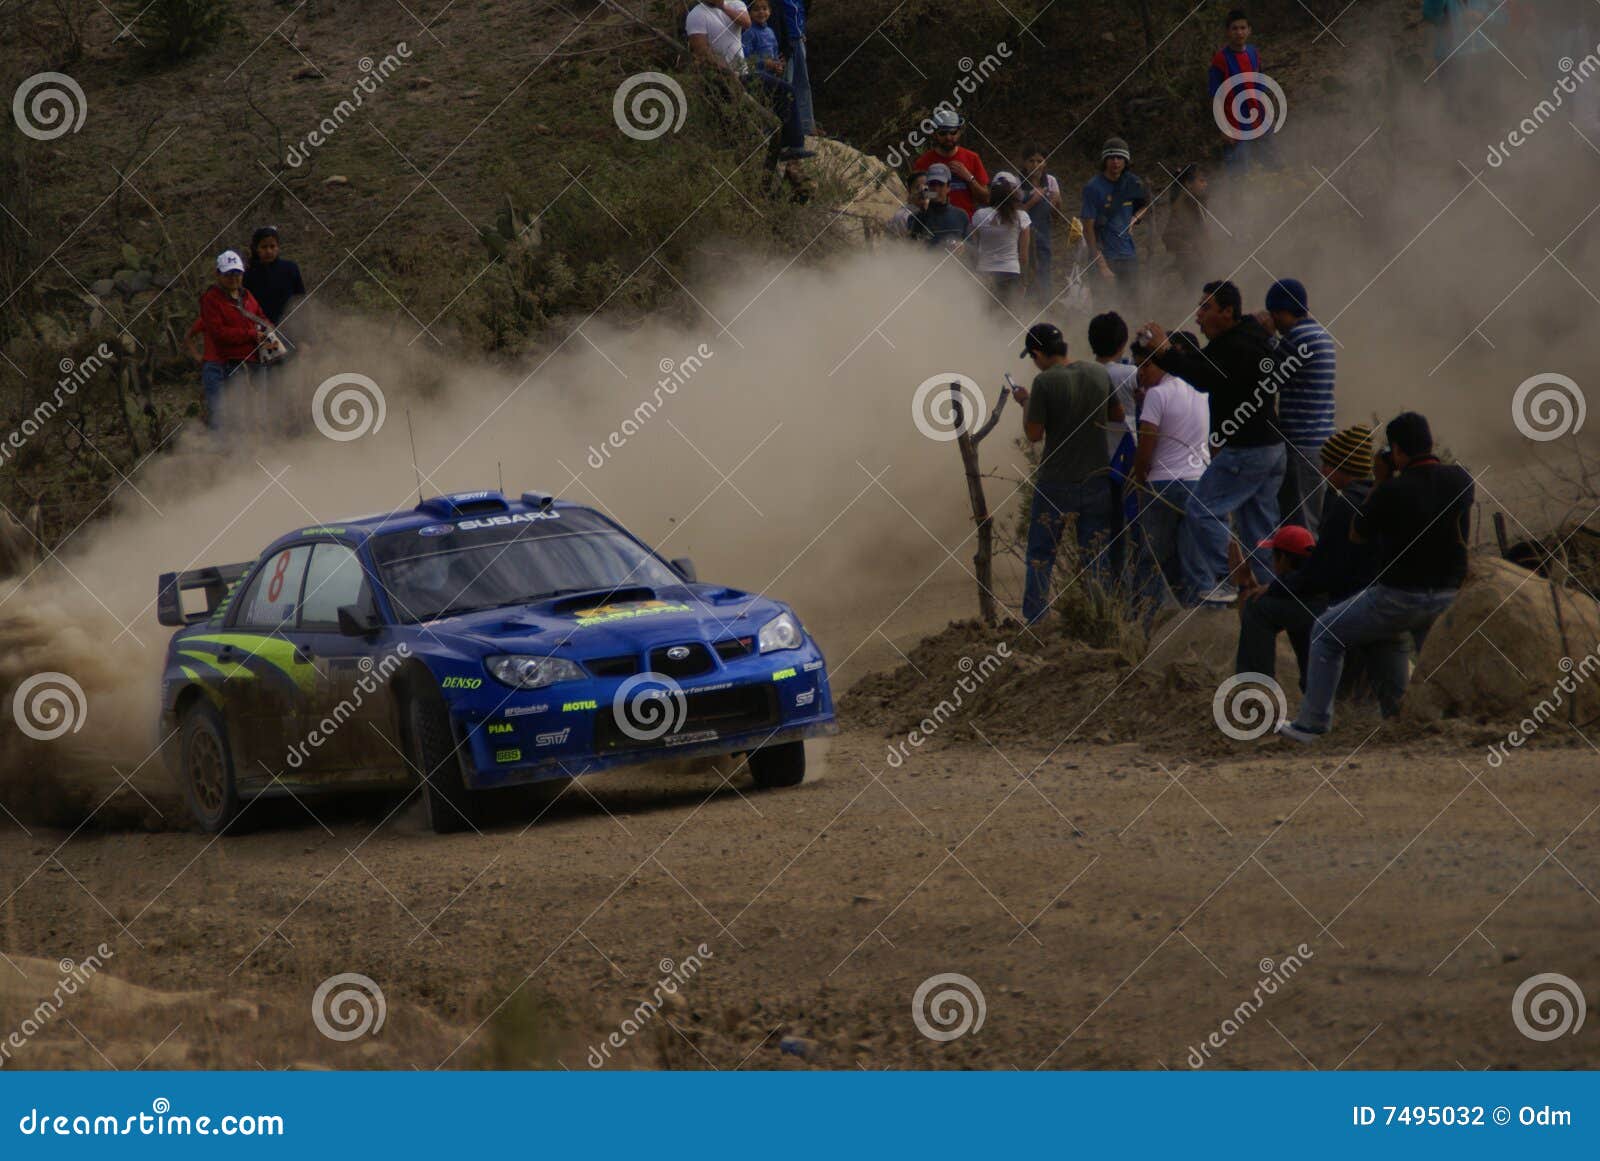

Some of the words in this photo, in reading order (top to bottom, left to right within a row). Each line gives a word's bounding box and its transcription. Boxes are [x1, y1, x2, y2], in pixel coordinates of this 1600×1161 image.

[458, 509, 560, 530] SUBARU
[268, 550, 291, 603] 8
[442, 676, 482, 689] DENSO
[562, 700, 598, 713] MOTUL
[488, 723, 514, 734] PIAA
